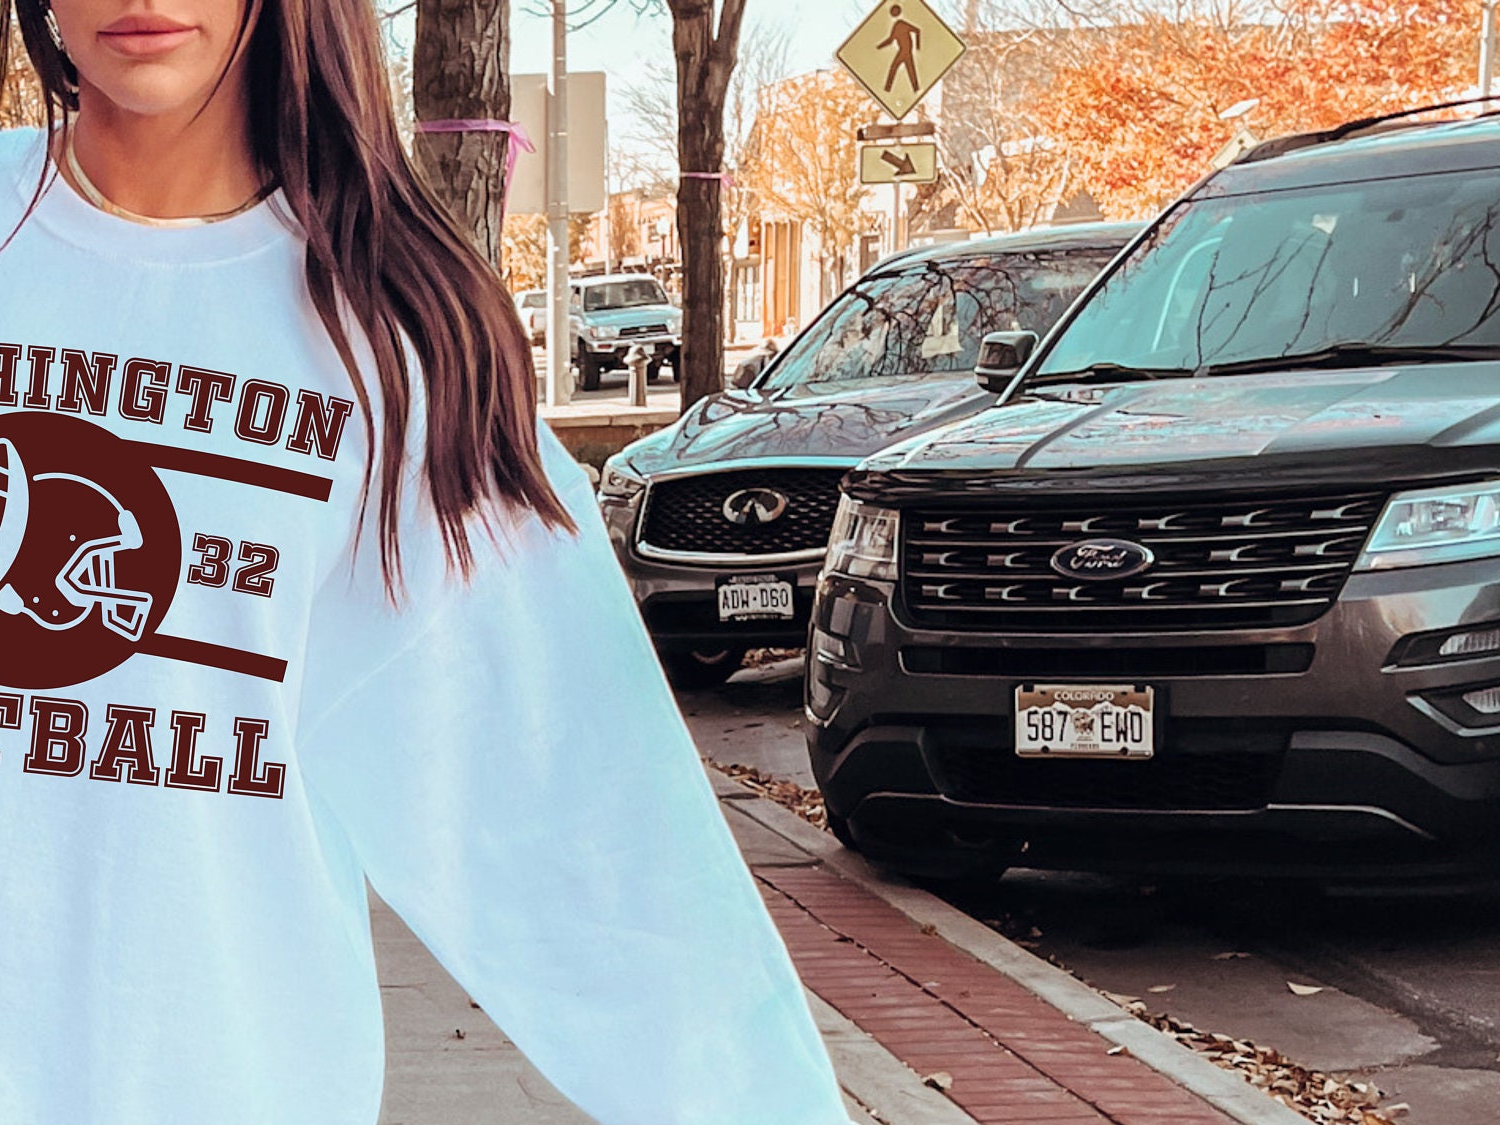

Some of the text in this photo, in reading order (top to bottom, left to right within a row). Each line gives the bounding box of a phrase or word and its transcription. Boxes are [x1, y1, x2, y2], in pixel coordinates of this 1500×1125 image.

[187, 533, 280, 598] 32
[1070, 544, 1128, 569] Ford
[1027, 710, 1068, 742] 587
